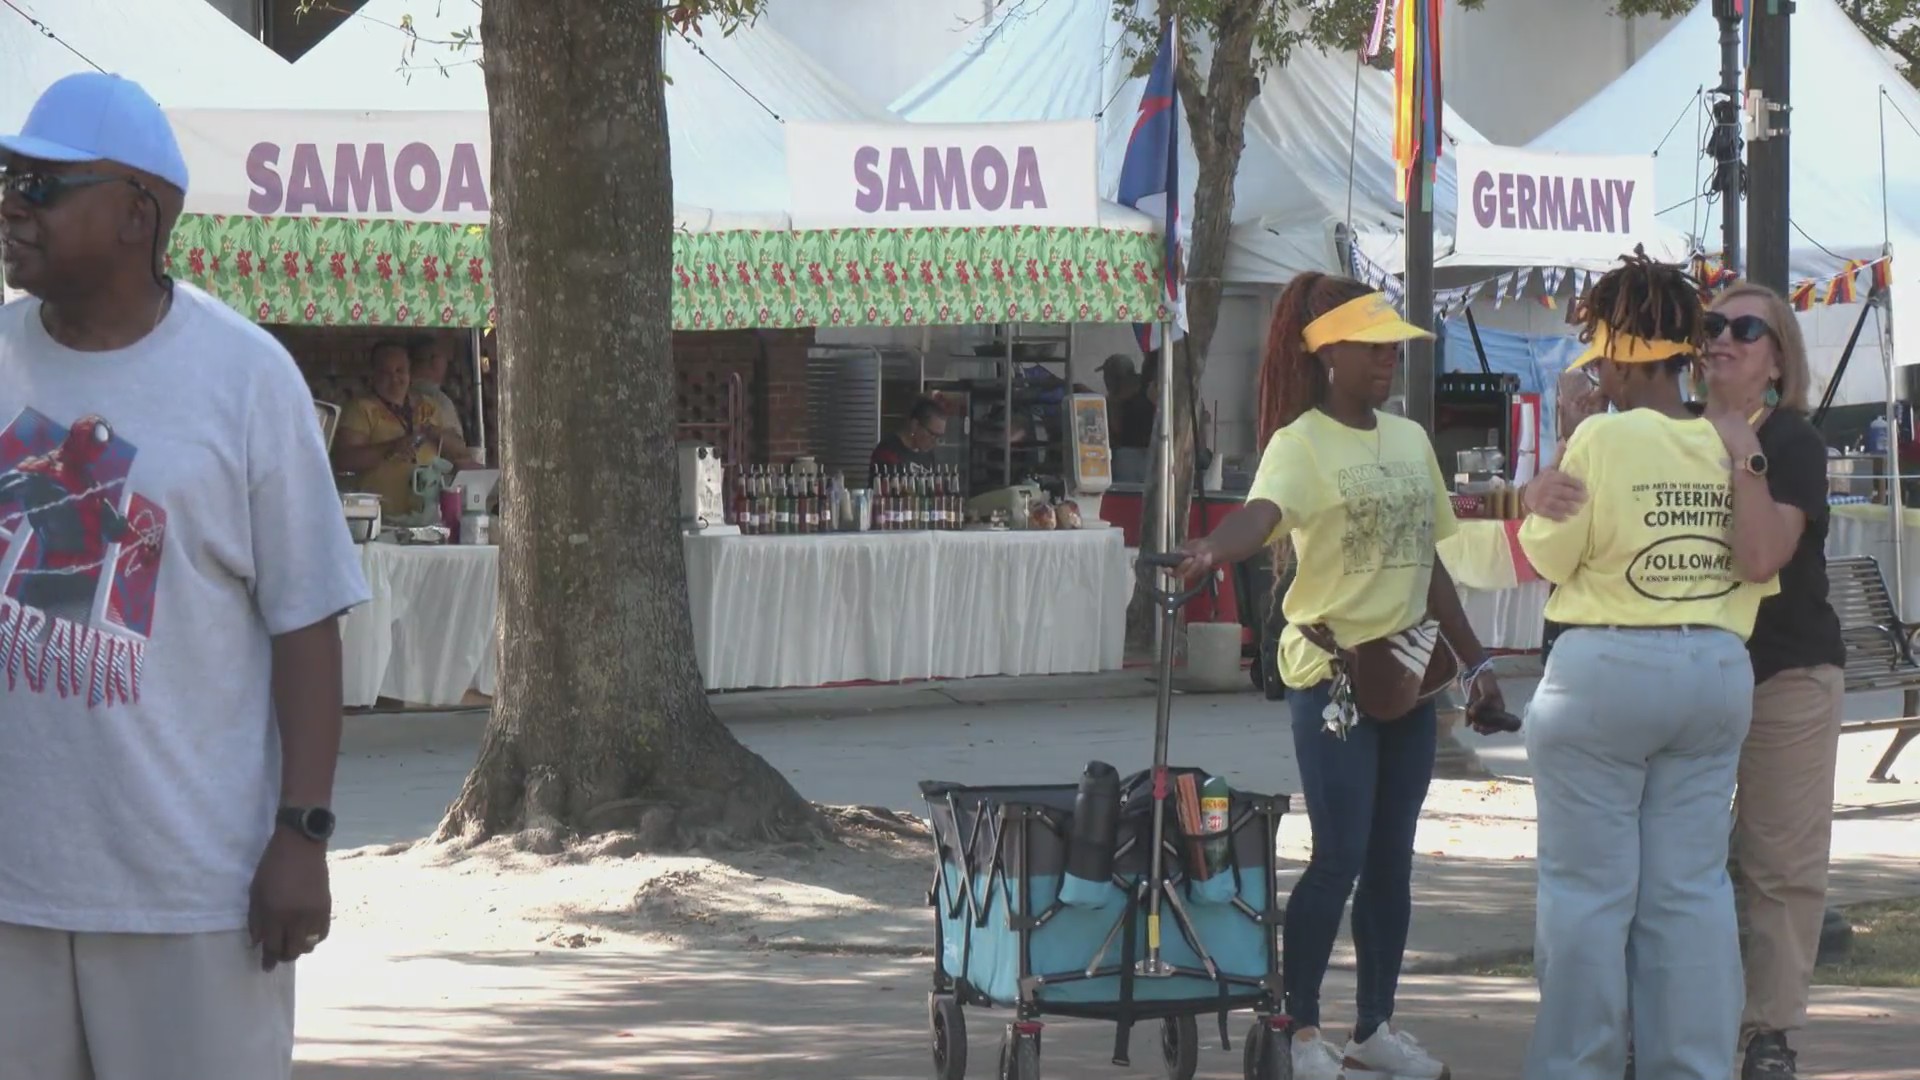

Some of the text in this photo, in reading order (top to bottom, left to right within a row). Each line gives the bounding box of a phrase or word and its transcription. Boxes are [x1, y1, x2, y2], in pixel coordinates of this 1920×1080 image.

[246, 141, 490, 215] SAMOA
[854, 145, 1048, 213] SAMOA
[1472, 170, 1636, 234] GERMANY
[1643, 511, 1733, 528] COMMITTE
